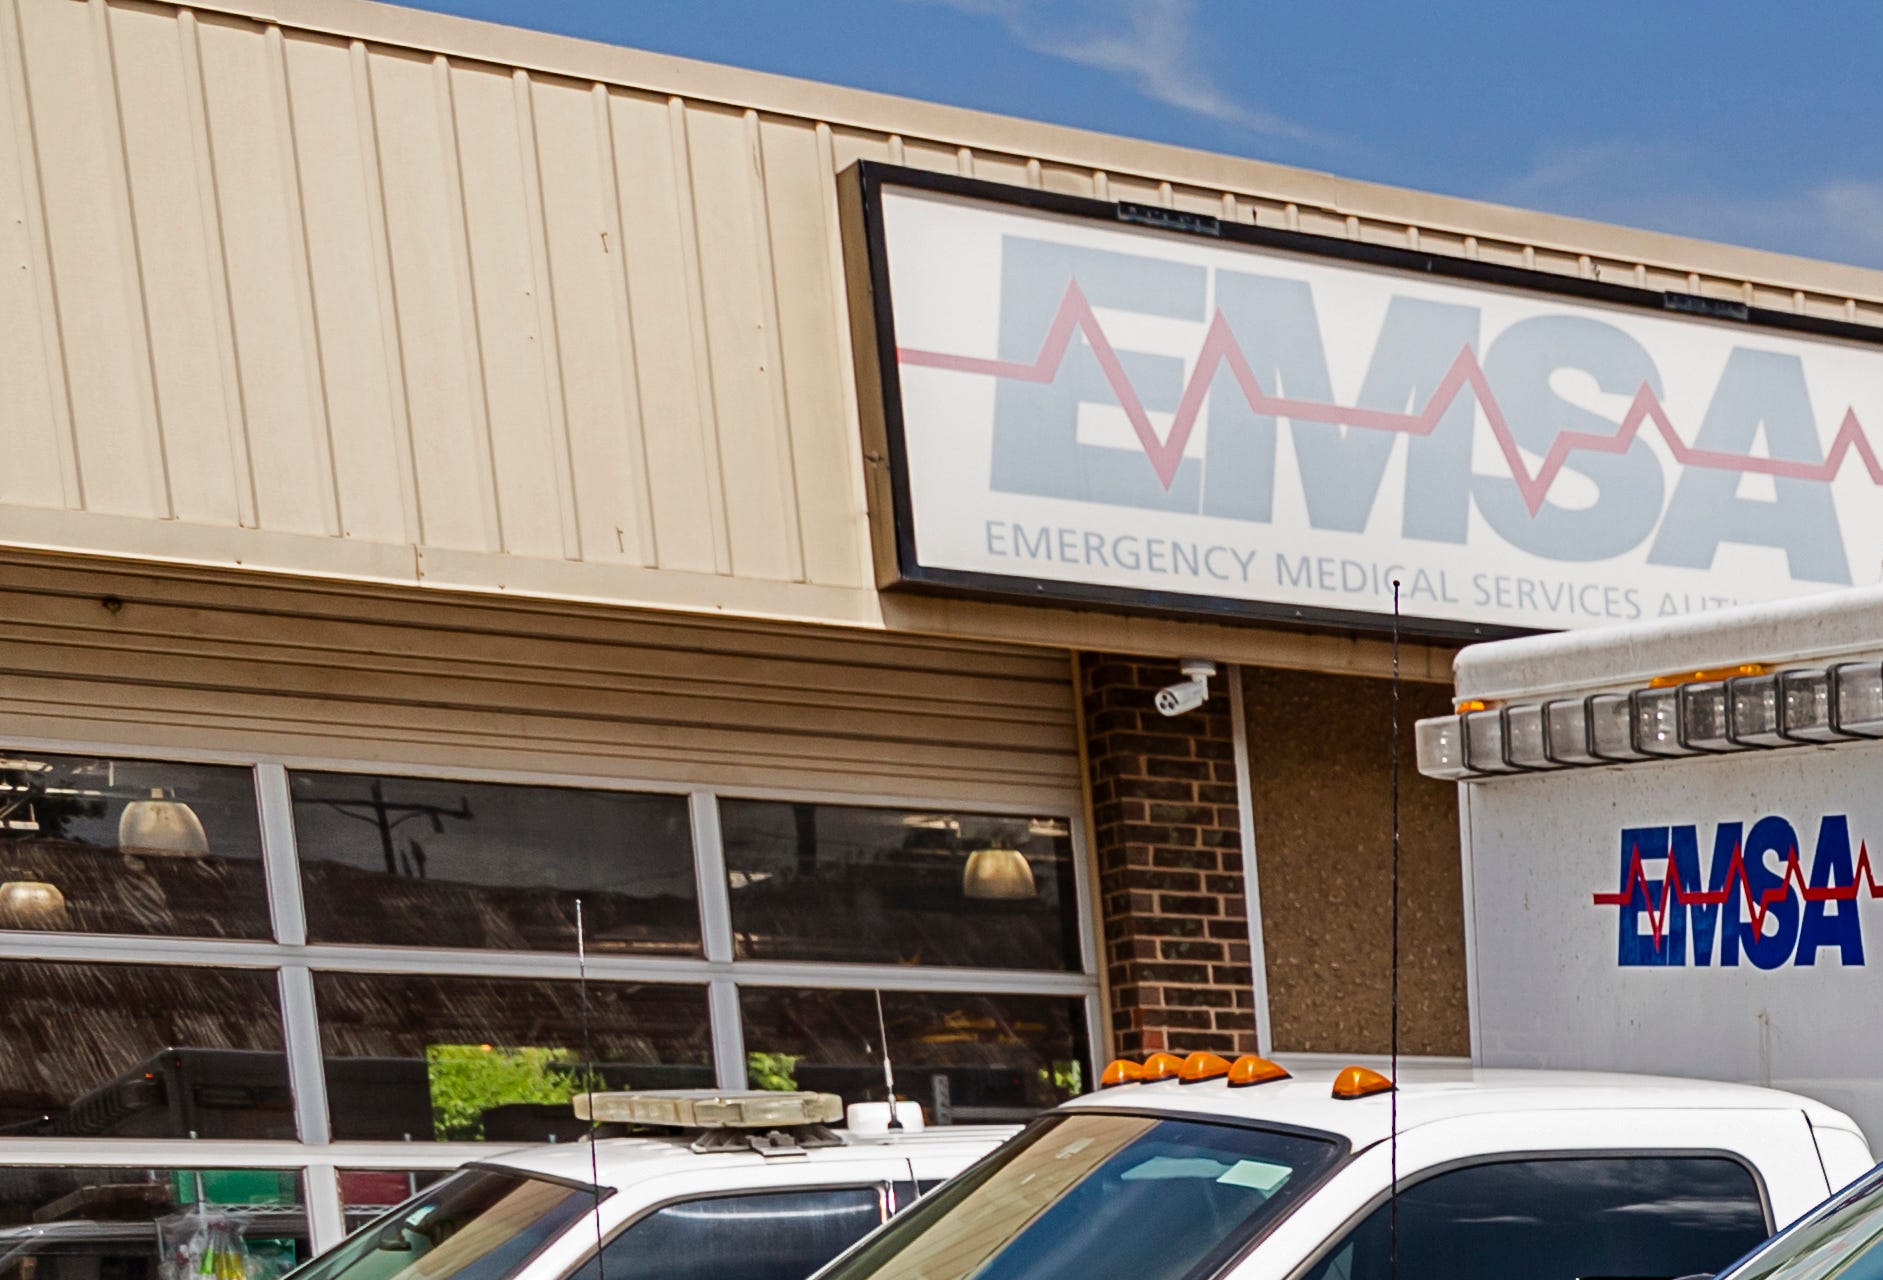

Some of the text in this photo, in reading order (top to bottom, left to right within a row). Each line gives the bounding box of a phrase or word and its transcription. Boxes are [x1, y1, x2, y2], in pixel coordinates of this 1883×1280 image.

[990, 235, 1852, 586] EMSA
[985, 519, 1257, 583] EMERGENCY
[1275, 553, 1459, 604] MEDICAL
[1473, 573, 1642, 620] SERVICES
[1618, 814, 1865, 970] EMSA
